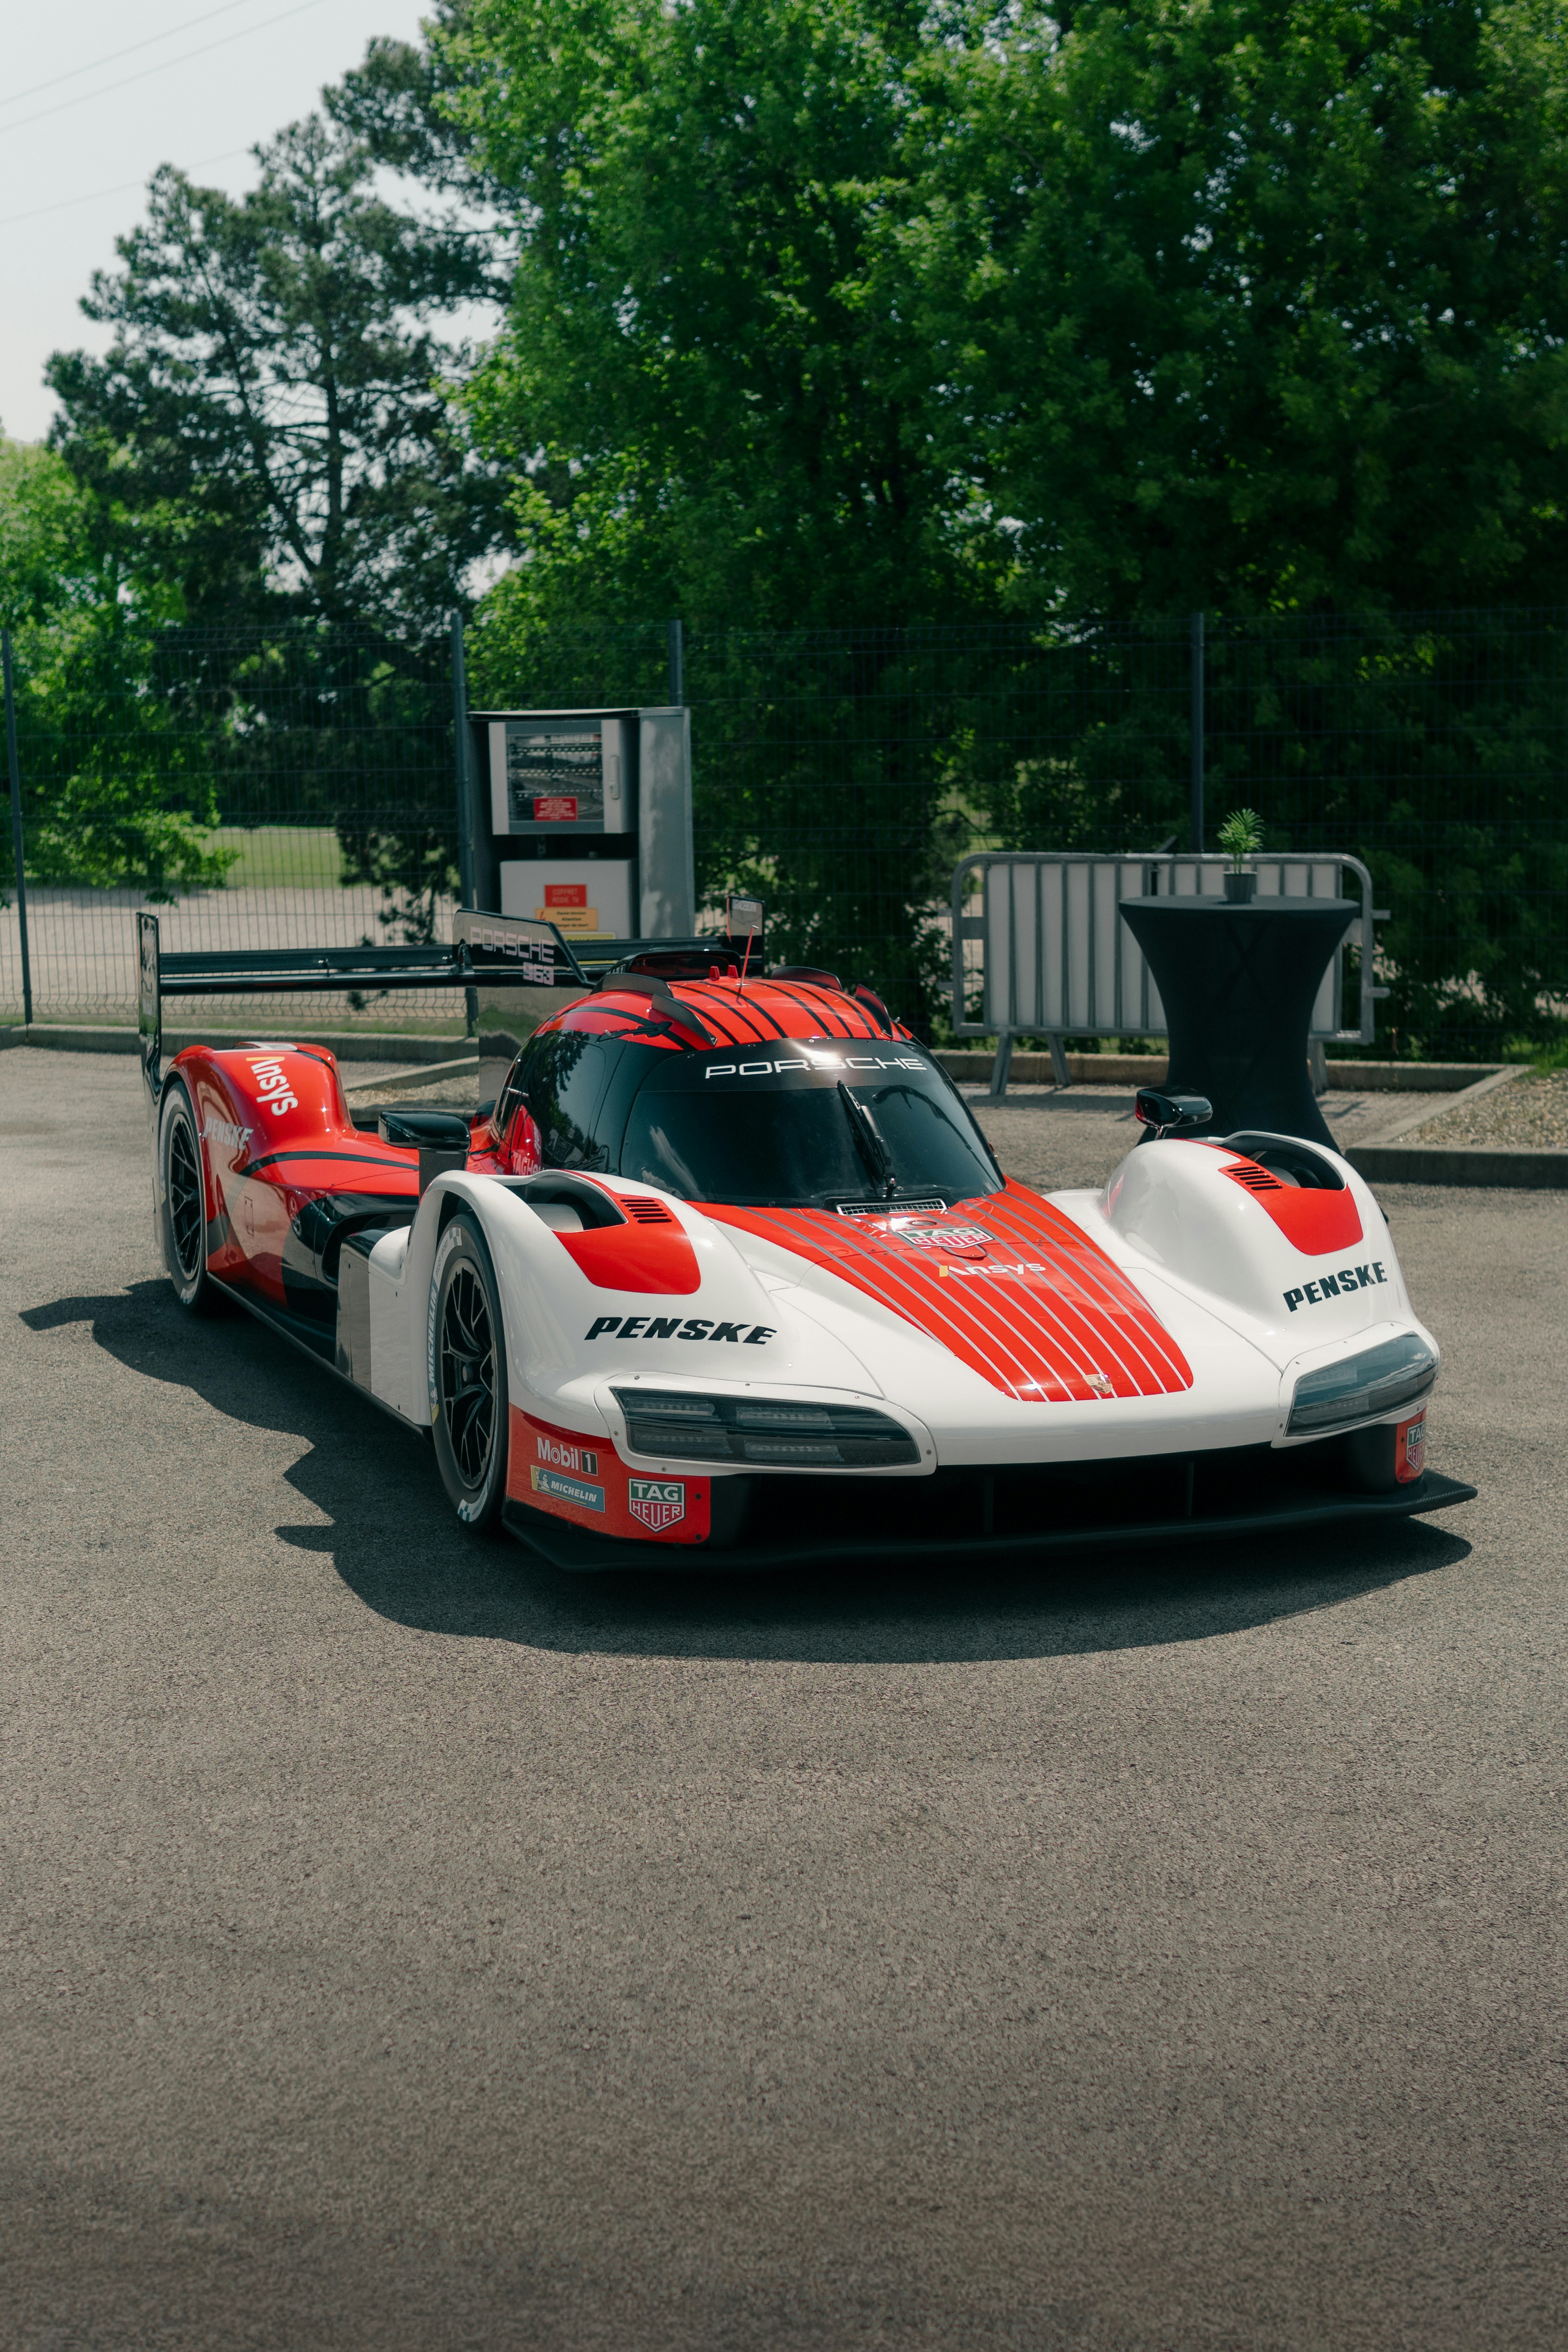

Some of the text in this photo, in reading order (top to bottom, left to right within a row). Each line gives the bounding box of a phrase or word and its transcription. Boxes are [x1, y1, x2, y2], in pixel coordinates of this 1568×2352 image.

[470, 927, 554, 963] PORSCHE
[523, 962, 554, 986] 963
[705, 1057, 928, 1079] PORSCHE
[202, 1117, 254, 1150] PENSKE
[915, 1234, 986, 1247] HEUER
[1283, 1262, 1388, 1313] PENSKE
[428, 1286, 437, 1383] MICHELIN
[584, 1317, 778, 1345] PENSKE
[537, 1436, 591, 1473] Mobil 1
[551, 1480, 597, 1503] MICHELIN
[633, 1483, 678, 1501] TAG
[633, 1502, 680, 1527] HEUER
